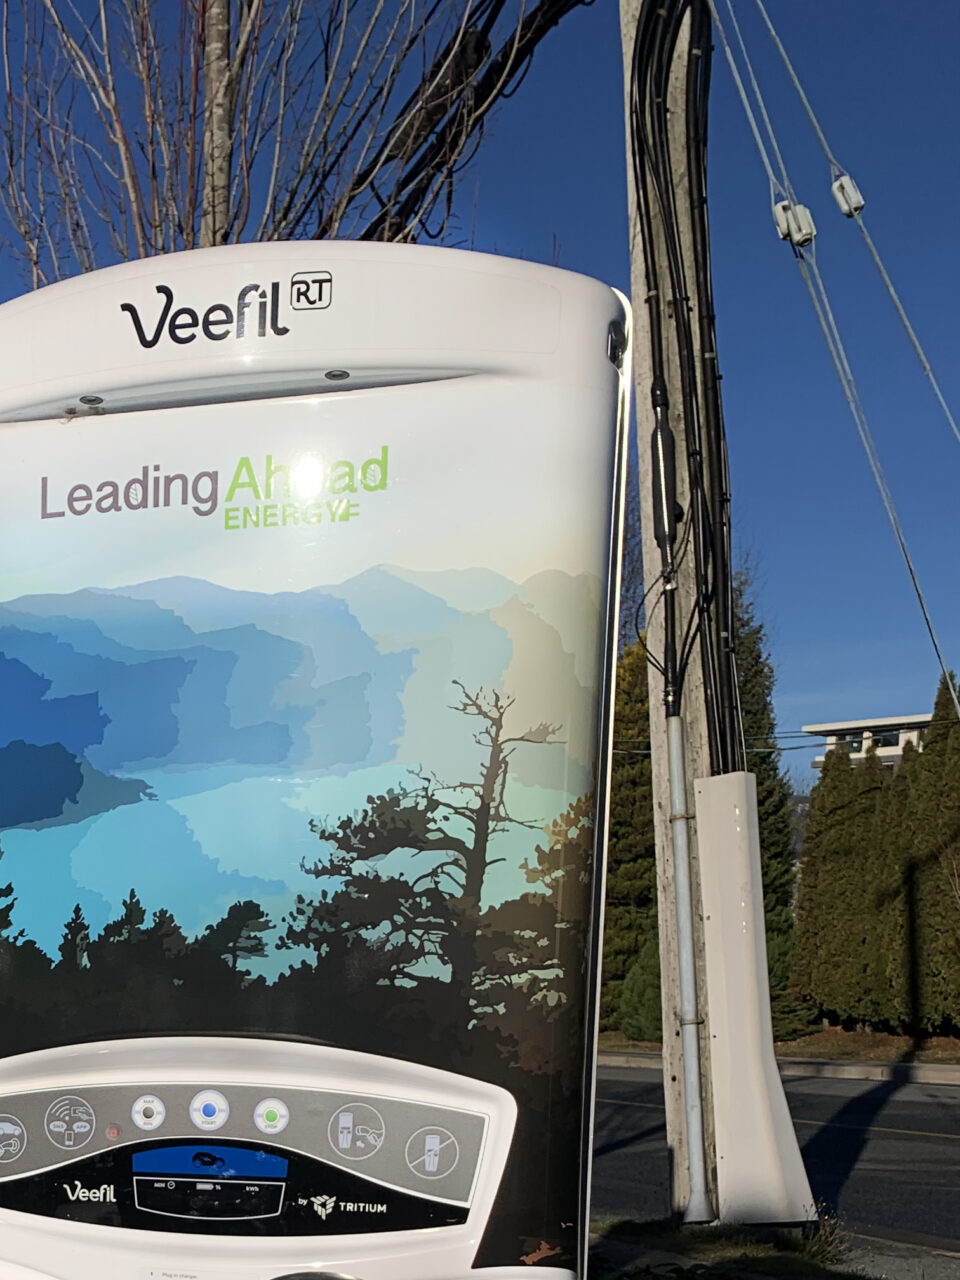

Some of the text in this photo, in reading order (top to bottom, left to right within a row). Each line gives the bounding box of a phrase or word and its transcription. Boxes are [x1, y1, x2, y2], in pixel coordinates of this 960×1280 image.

[121, 276, 332, 349] Veefil RT
[40, 445, 389, 520] Leading Ahad
[224, 500, 342, 531] ENERGY
[62, 1180, 117, 1202] Veefil
[298, 1198, 387, 1213] by TRITIUM
